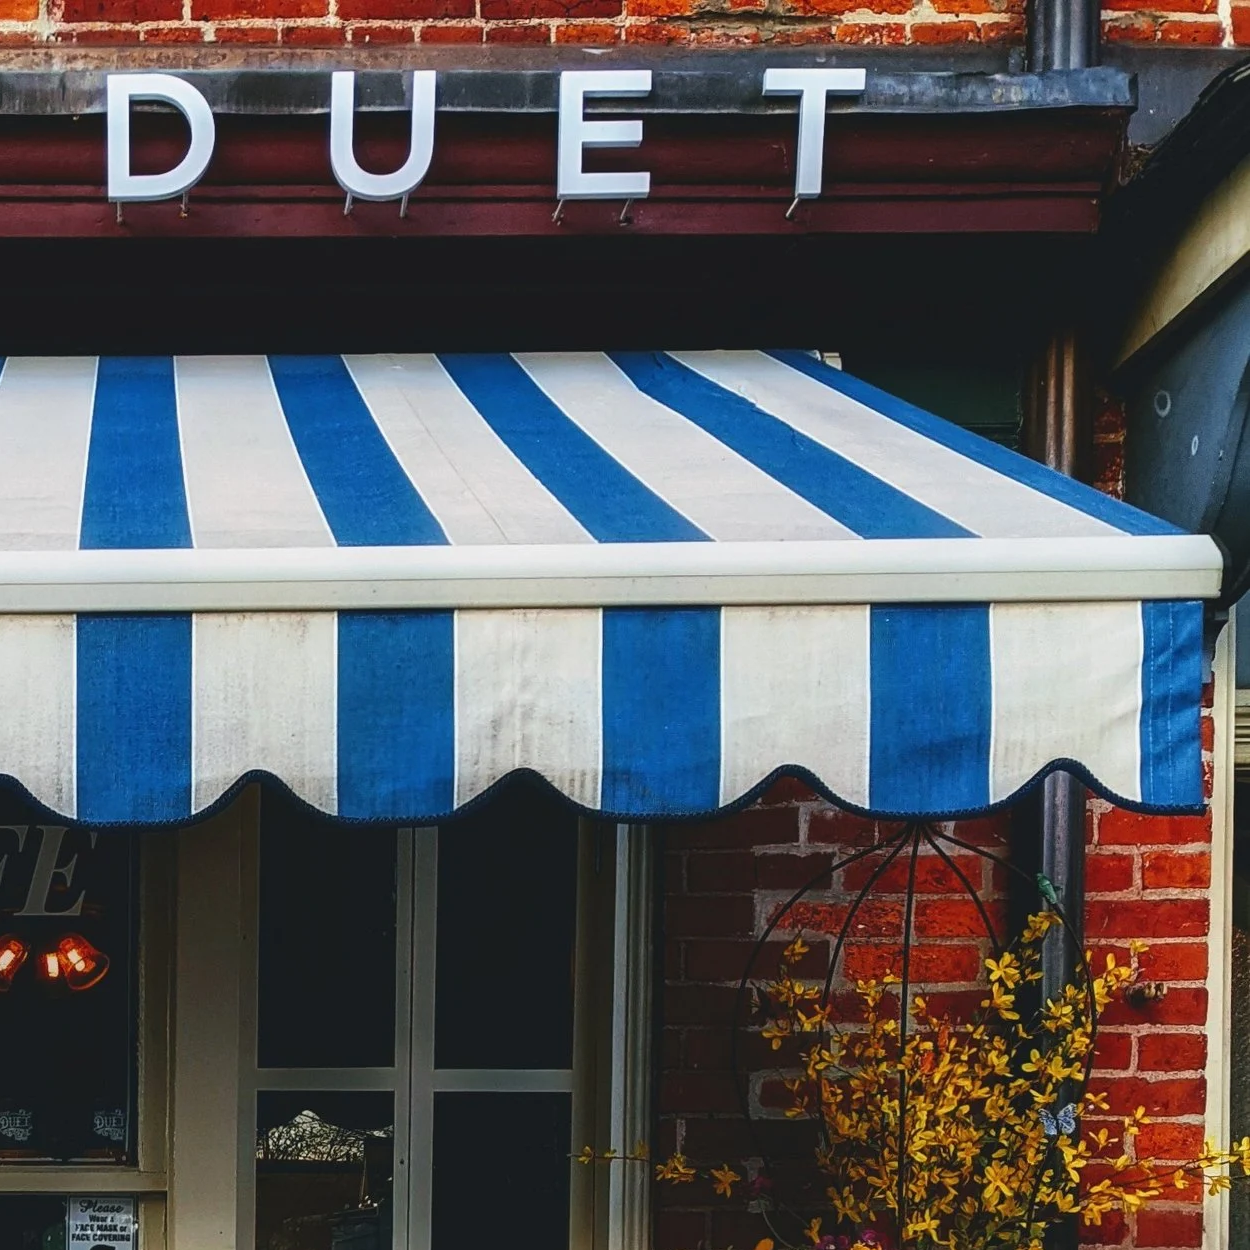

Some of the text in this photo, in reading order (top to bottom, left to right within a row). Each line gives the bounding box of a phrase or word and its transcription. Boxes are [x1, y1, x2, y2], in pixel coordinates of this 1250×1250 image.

[107, 68, 866, 202] DUET
[79, 1200, 124, 1213] Please
[97, 1224, 118, 1232] MASK
